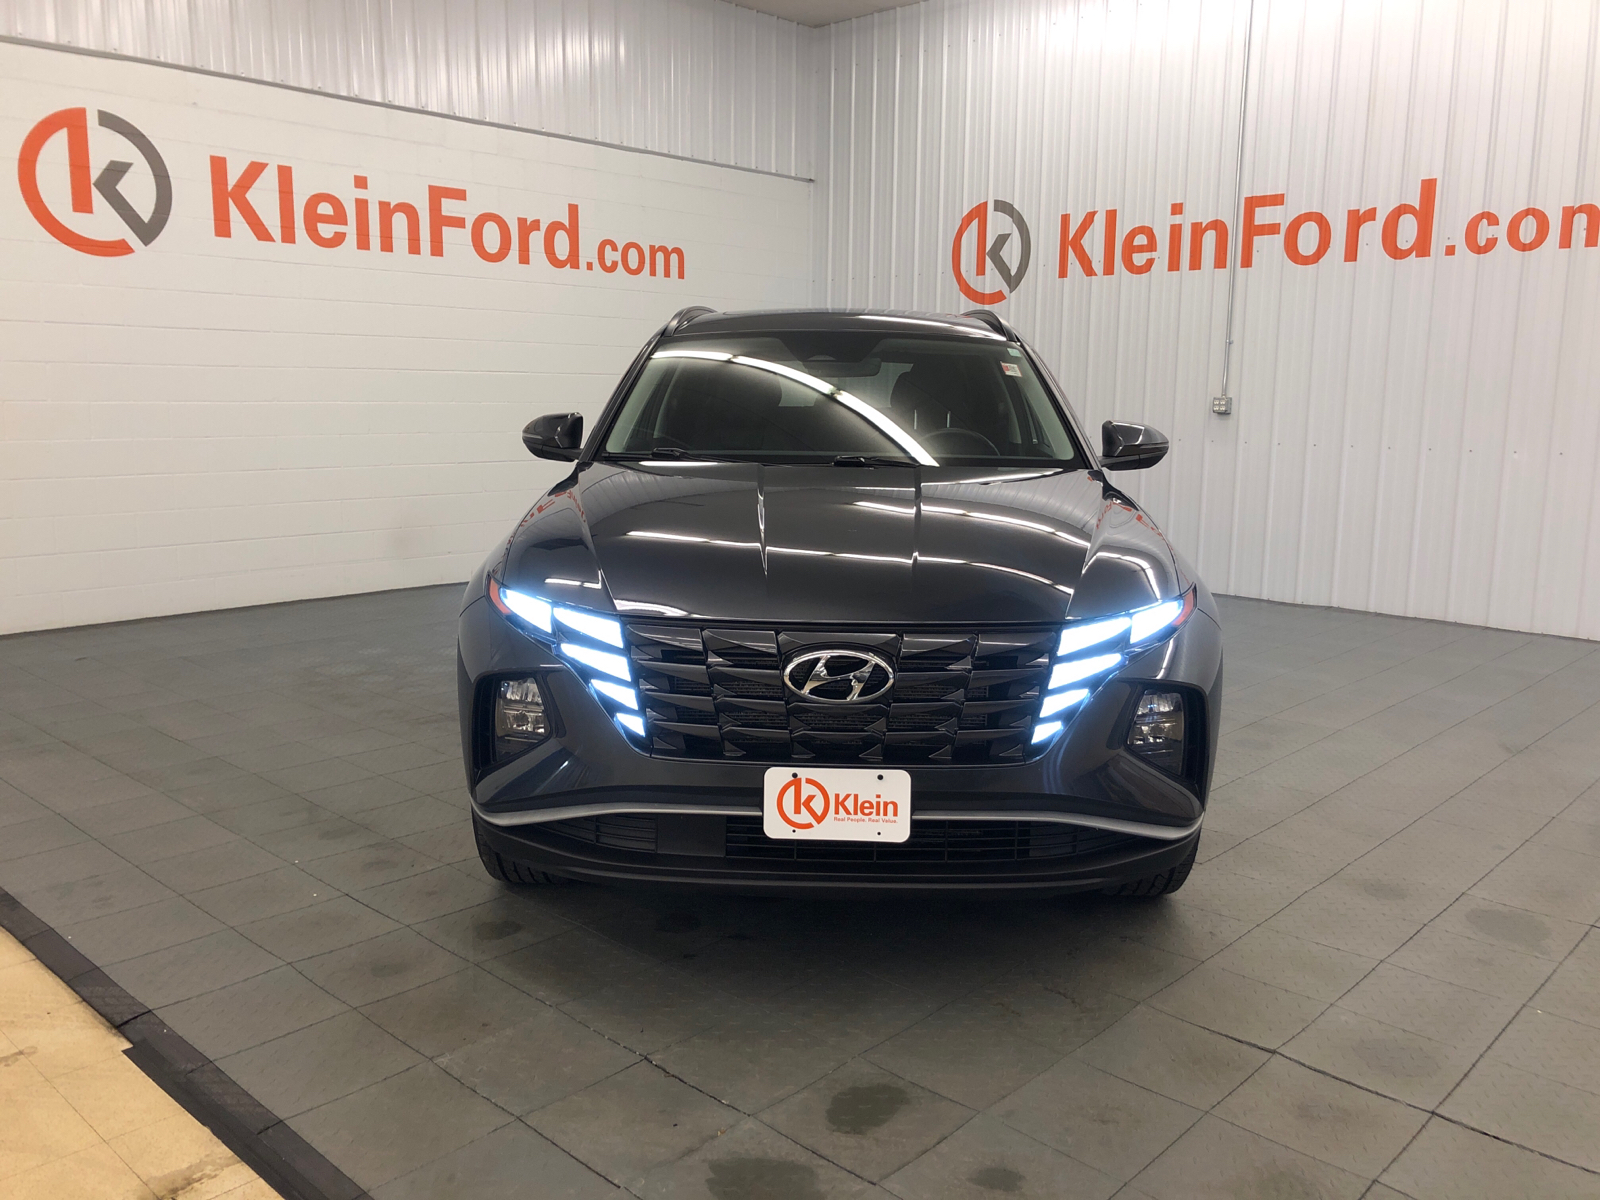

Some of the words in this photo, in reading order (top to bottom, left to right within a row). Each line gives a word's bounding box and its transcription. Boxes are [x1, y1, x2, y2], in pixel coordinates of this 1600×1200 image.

[209, 153, 687, 281] KleinFord.com
[833, 793, 899, 818] Klein
[847, 816, 867, 824] People.
